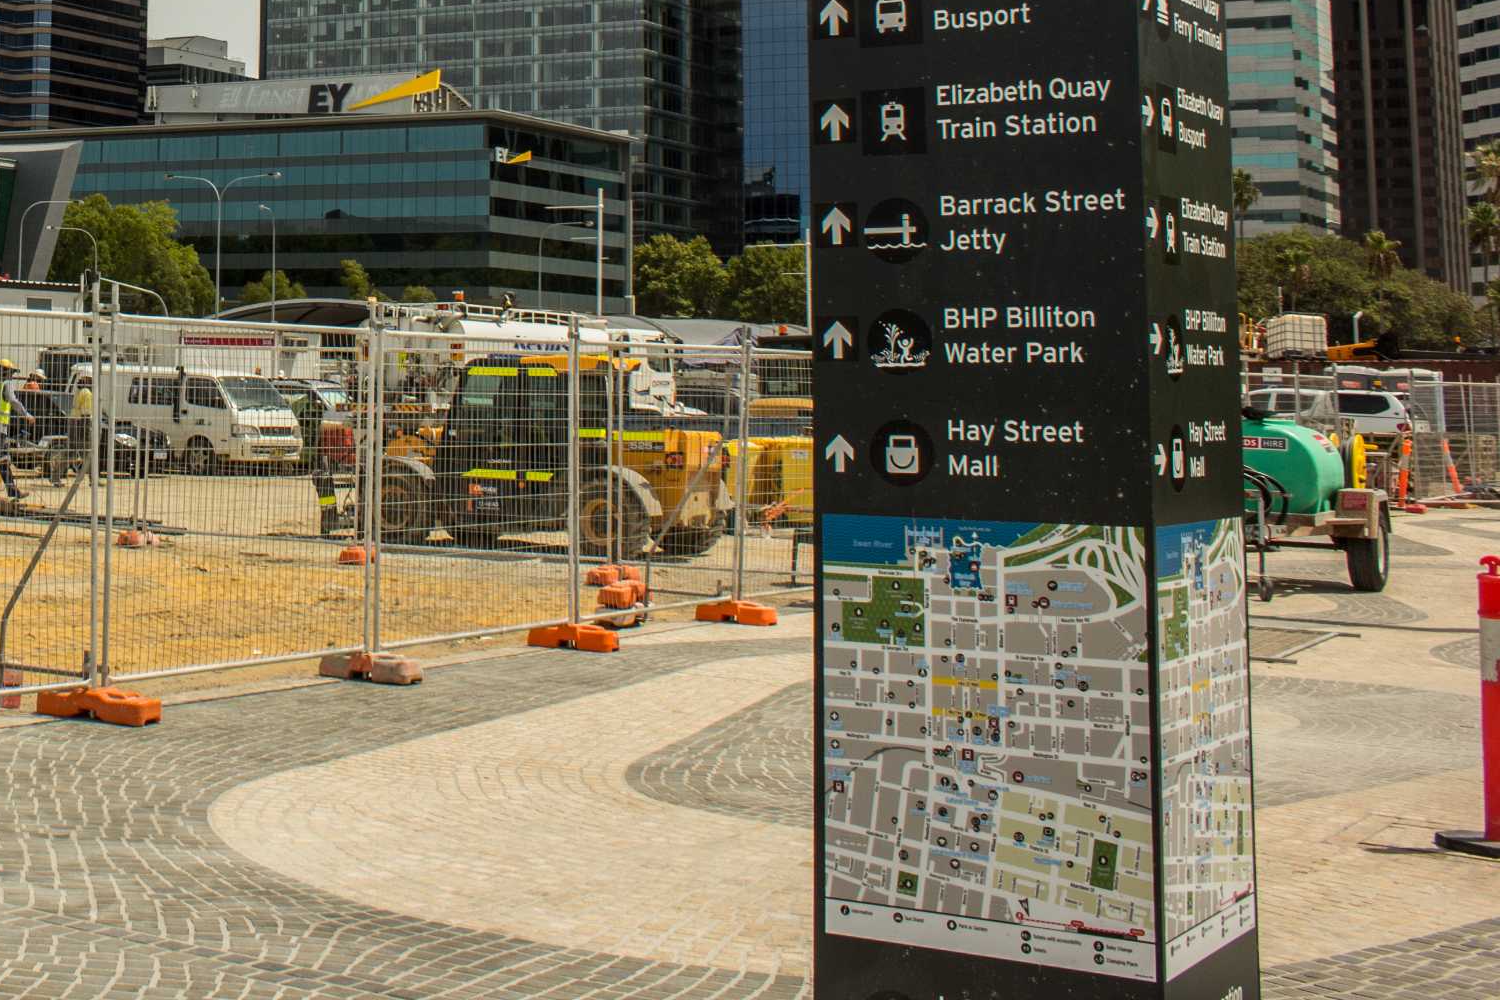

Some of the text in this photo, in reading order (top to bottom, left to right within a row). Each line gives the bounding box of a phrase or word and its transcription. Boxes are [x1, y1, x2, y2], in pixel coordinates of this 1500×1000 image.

[933, 2, 1031, 31] Busport
[1173, 12, 1223, 51] Ferry Terminal
[307, 82, 353, 113] EY
[936, 77, 1111, 106] Elizabeth Quay
[1176, 87, 1224, 126] Elizabeth Quay
[936, 111, 1097, 140] Train Station
[1177, 121, 1207, 149] Busport
[495, 146, 509, 163] EY
[940, 188, 1125, 216] Barrack Street
[1181, 197, 1228, 231] Elizabeth Quay
[940, 227, 1007, 254] Jetty
[1182, 231, 1227, 258] Train Station
[944, 305, 1096, 329] BHP Billiton
[1185, 309, 1226, 333] BHP Billiton
[944, 341, 1085, 364] Water Park
[1186, 344, 1225, 366] Water Park
[947, 419, 1084, 446] Hay Street
[1188, 421, 1227, 447] Hay Street
[1263, 439, 1284, 449] HIRE
[948, 454, 998, 477] Mall
[1189, 456, 1206, 478] Mall
